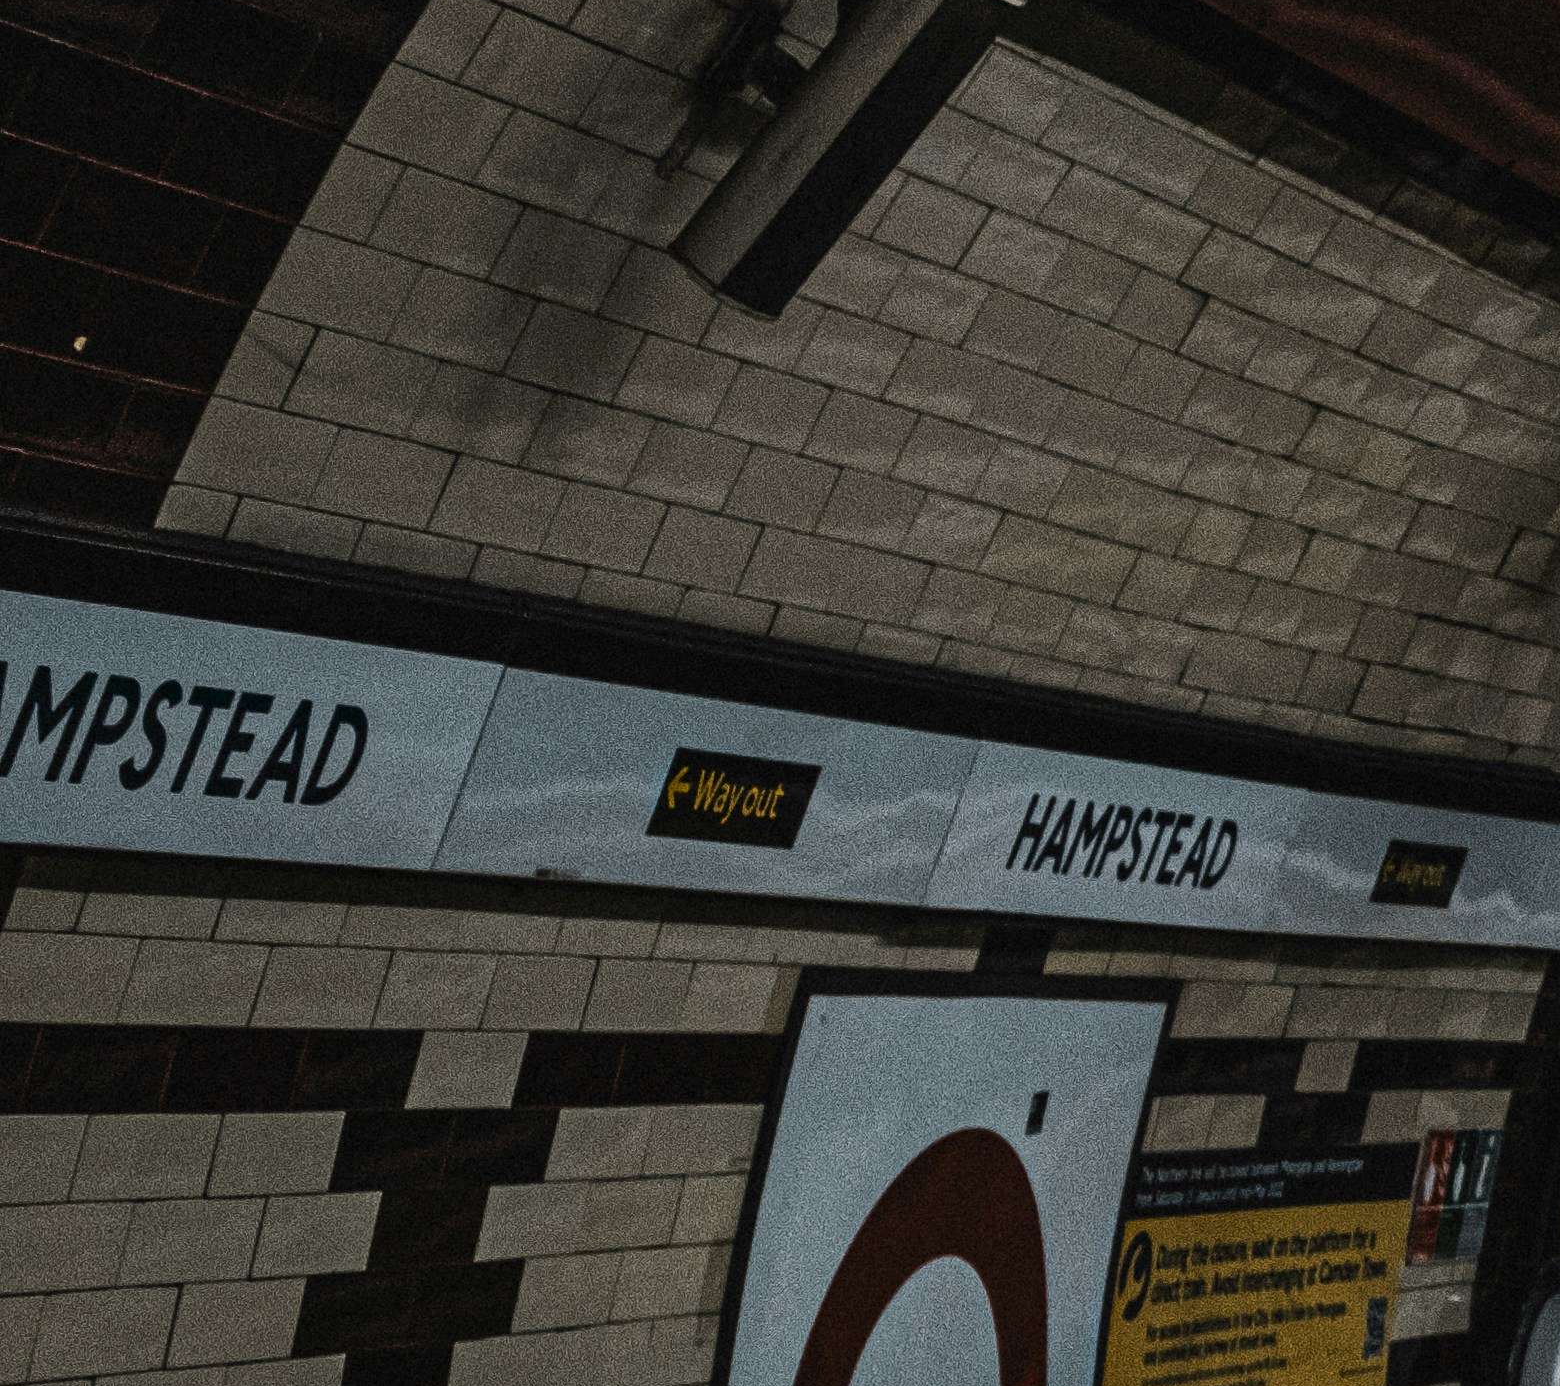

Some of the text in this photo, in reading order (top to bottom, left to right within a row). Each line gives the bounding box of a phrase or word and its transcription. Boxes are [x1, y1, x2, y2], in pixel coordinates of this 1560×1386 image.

[0, 663, 368, 805] MPSTEAD
[694, 768, 783, 822] Way out
[1006, 792, 1240, 890] HAMPSTEAD
